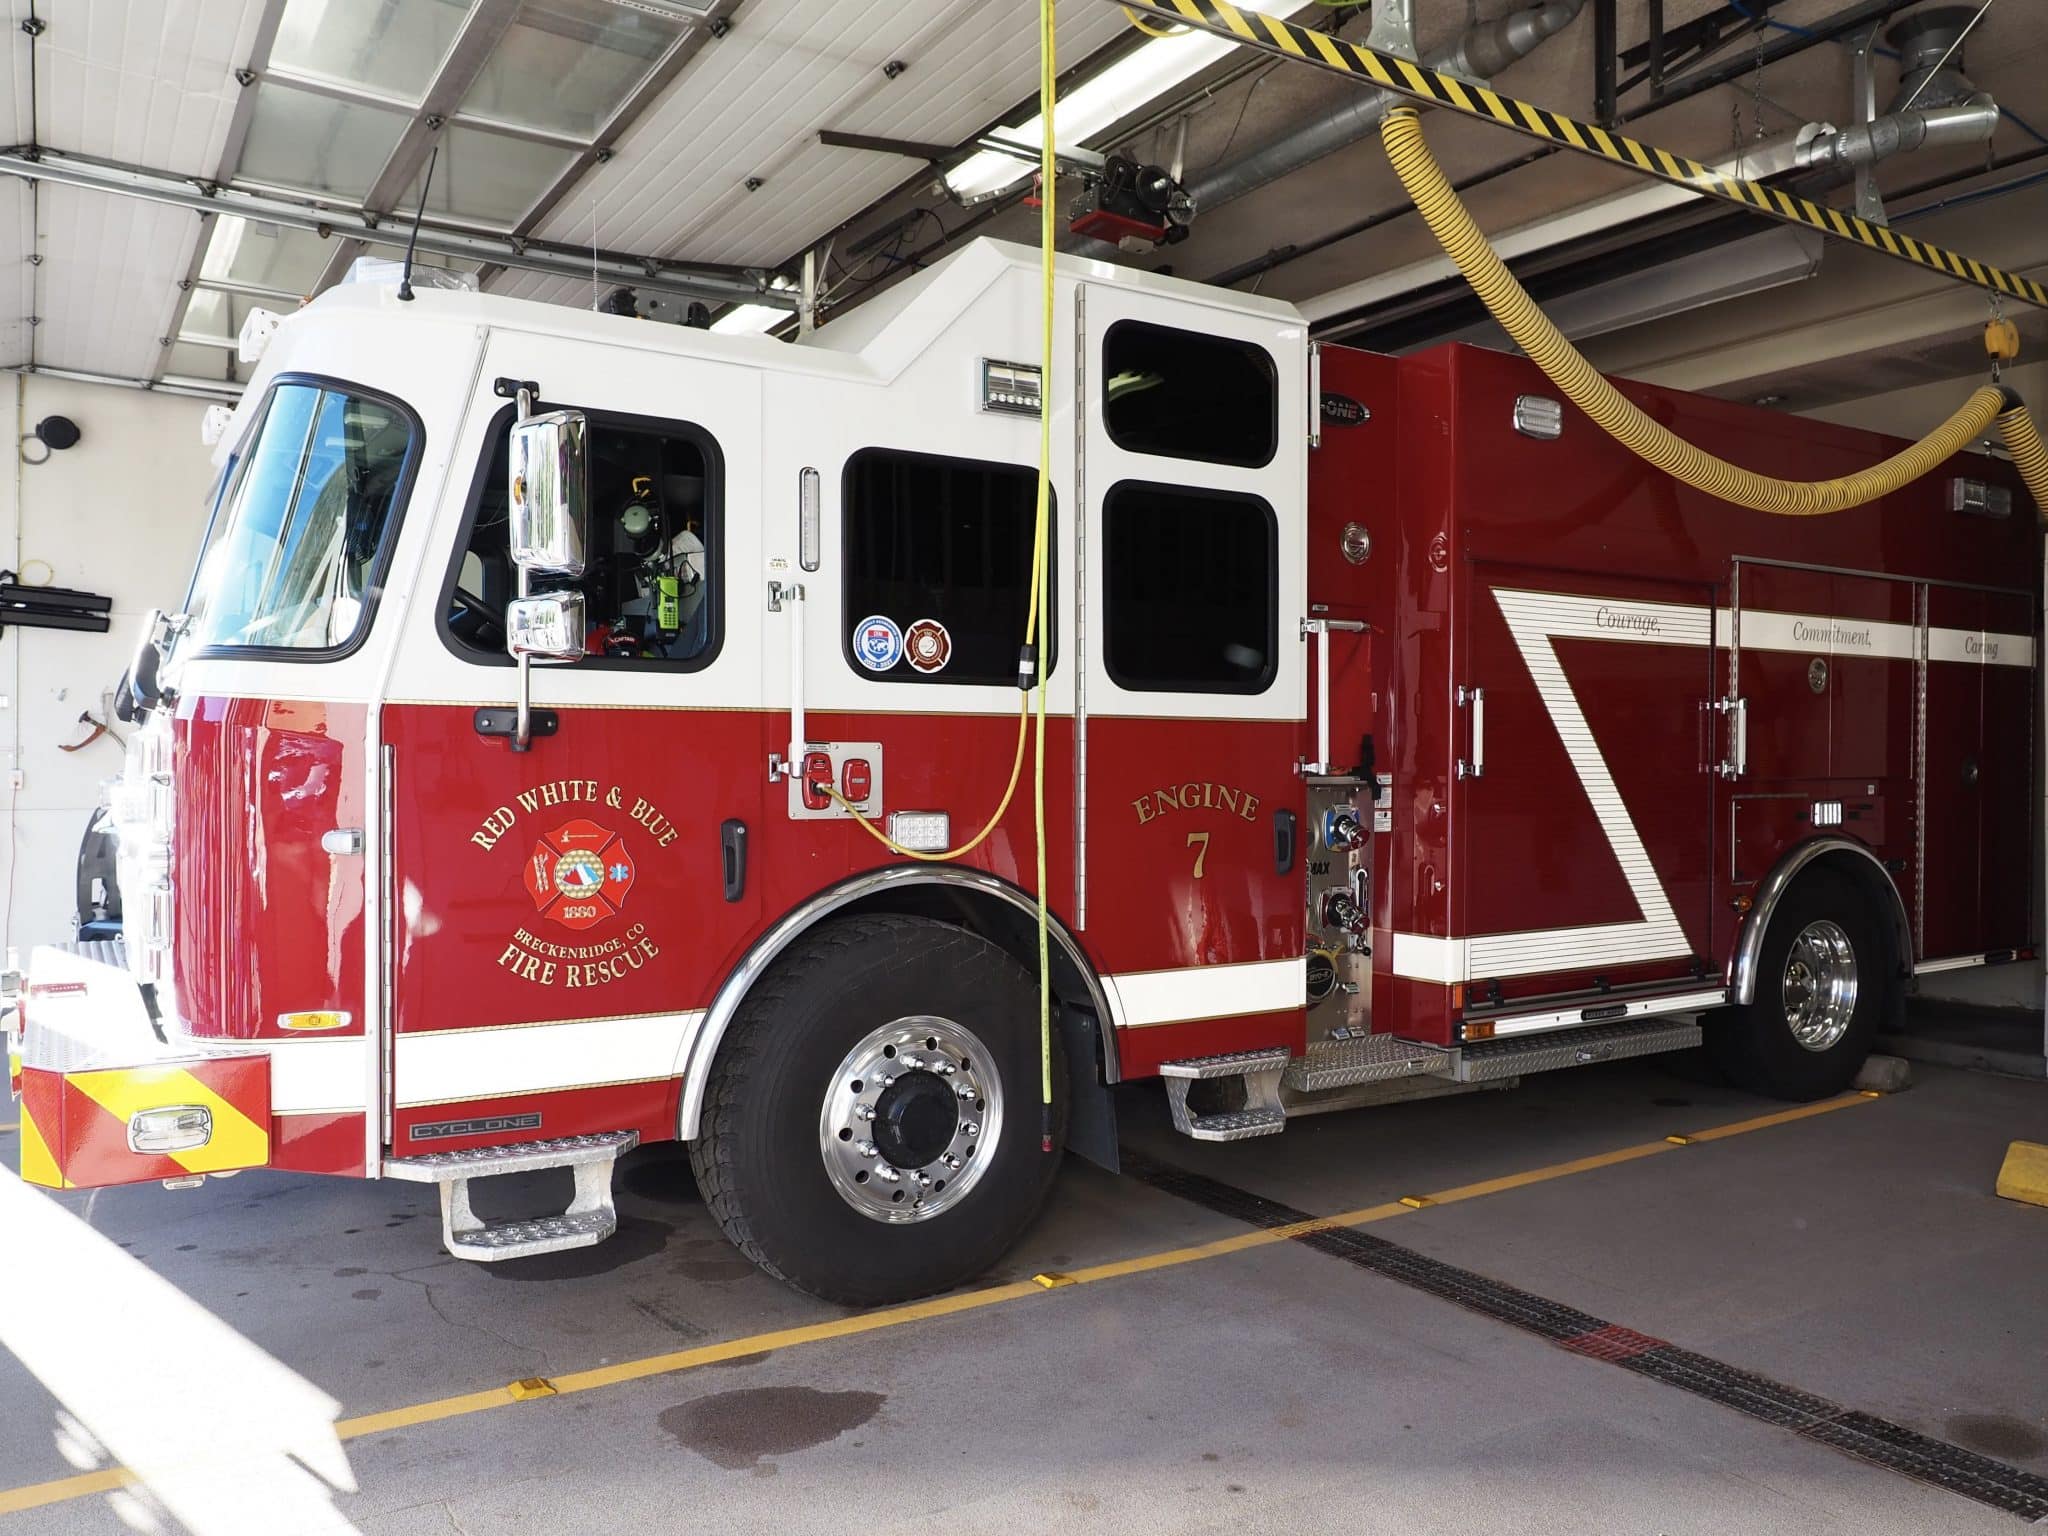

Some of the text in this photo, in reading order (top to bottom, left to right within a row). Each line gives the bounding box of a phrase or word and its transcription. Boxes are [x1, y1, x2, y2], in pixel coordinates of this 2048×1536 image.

[1320, 400, 1358, 419] -ONE
[1596, 606, 1661, 636] Courage,
[1793, 621, 1872, 649] Commitment,
[1964, 636, 1999, 660] Caring
[471, 779, 679, 852] RED WHITE & BLUE
[1130, 782, 1260, 825] ENGINE
[1187, 832, 1209, 879] 7
[513, 922, 645, 960] BRECKENRIDGE, CO
[496, 936, 660, 989] FIRE RESCUE
[414, 1115, 538, 1137] CYCLONE
